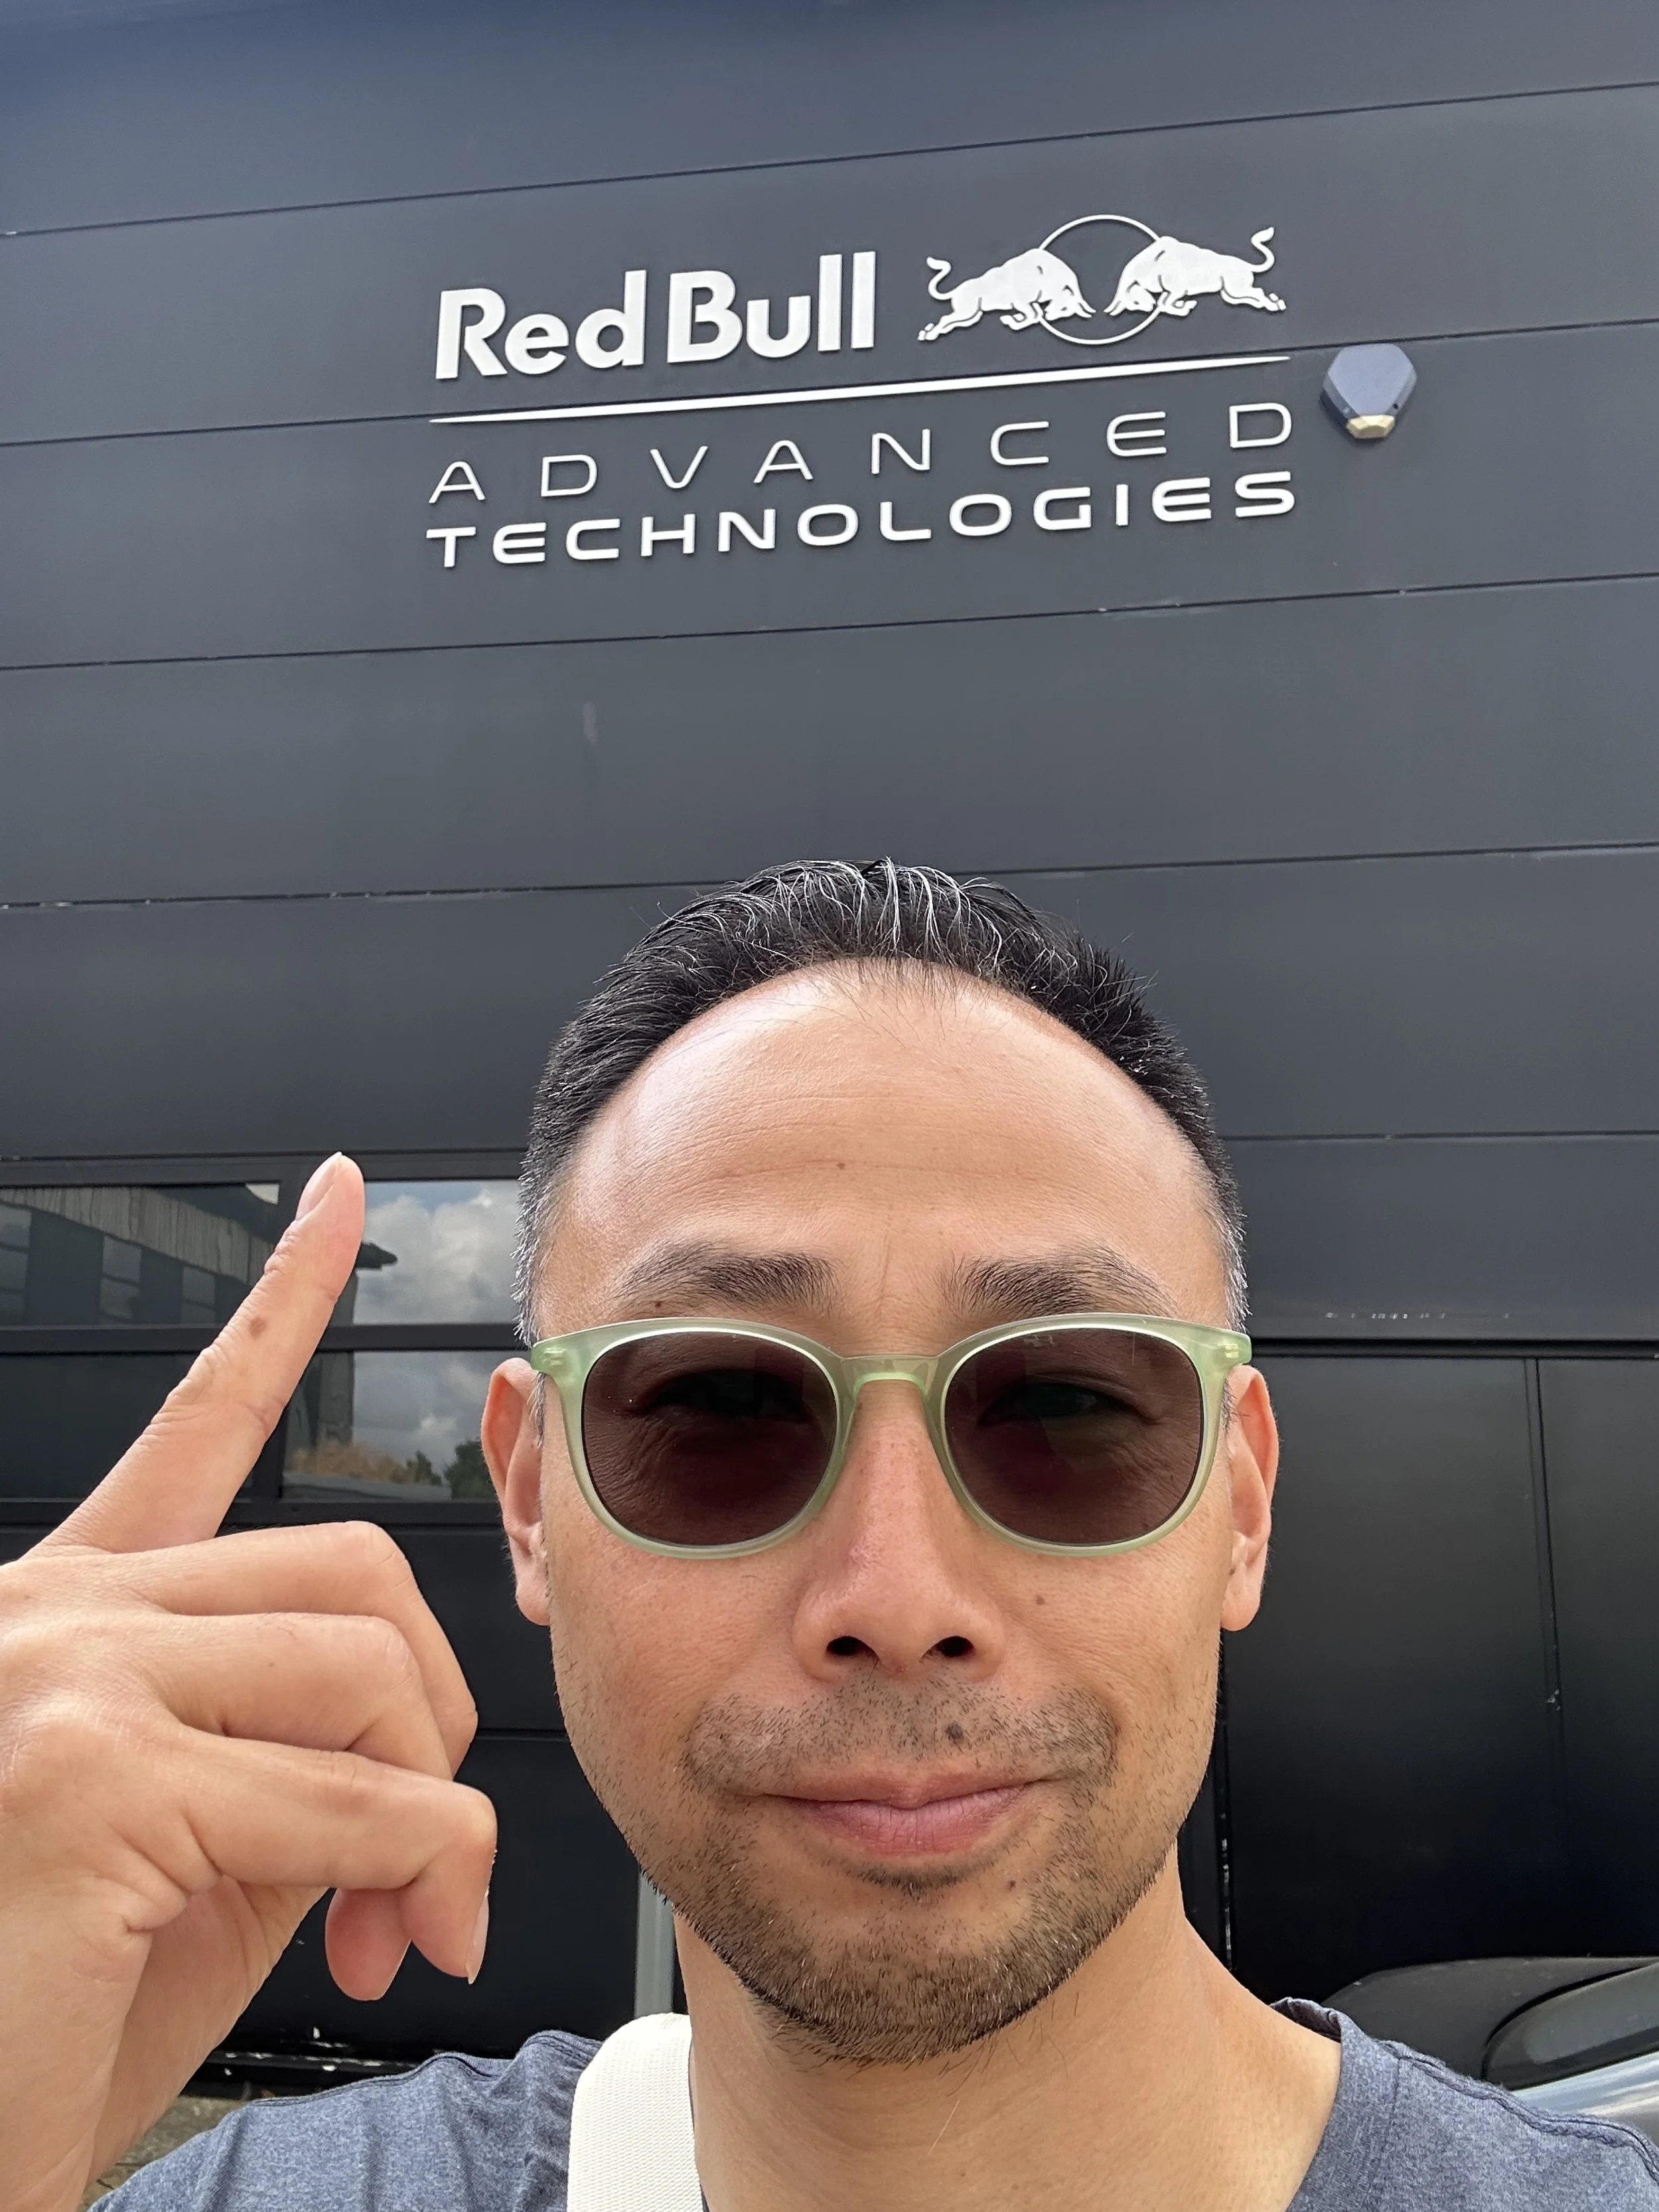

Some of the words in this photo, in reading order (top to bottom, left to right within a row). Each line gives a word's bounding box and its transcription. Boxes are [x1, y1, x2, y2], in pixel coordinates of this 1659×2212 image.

[435, 269, 647, 380] Red
[666, 251, 876, 364] Bull
[428, 402, 1292, 504] ADVANCED
[425, 471, 1295, 569] TECHNOLOGIES
